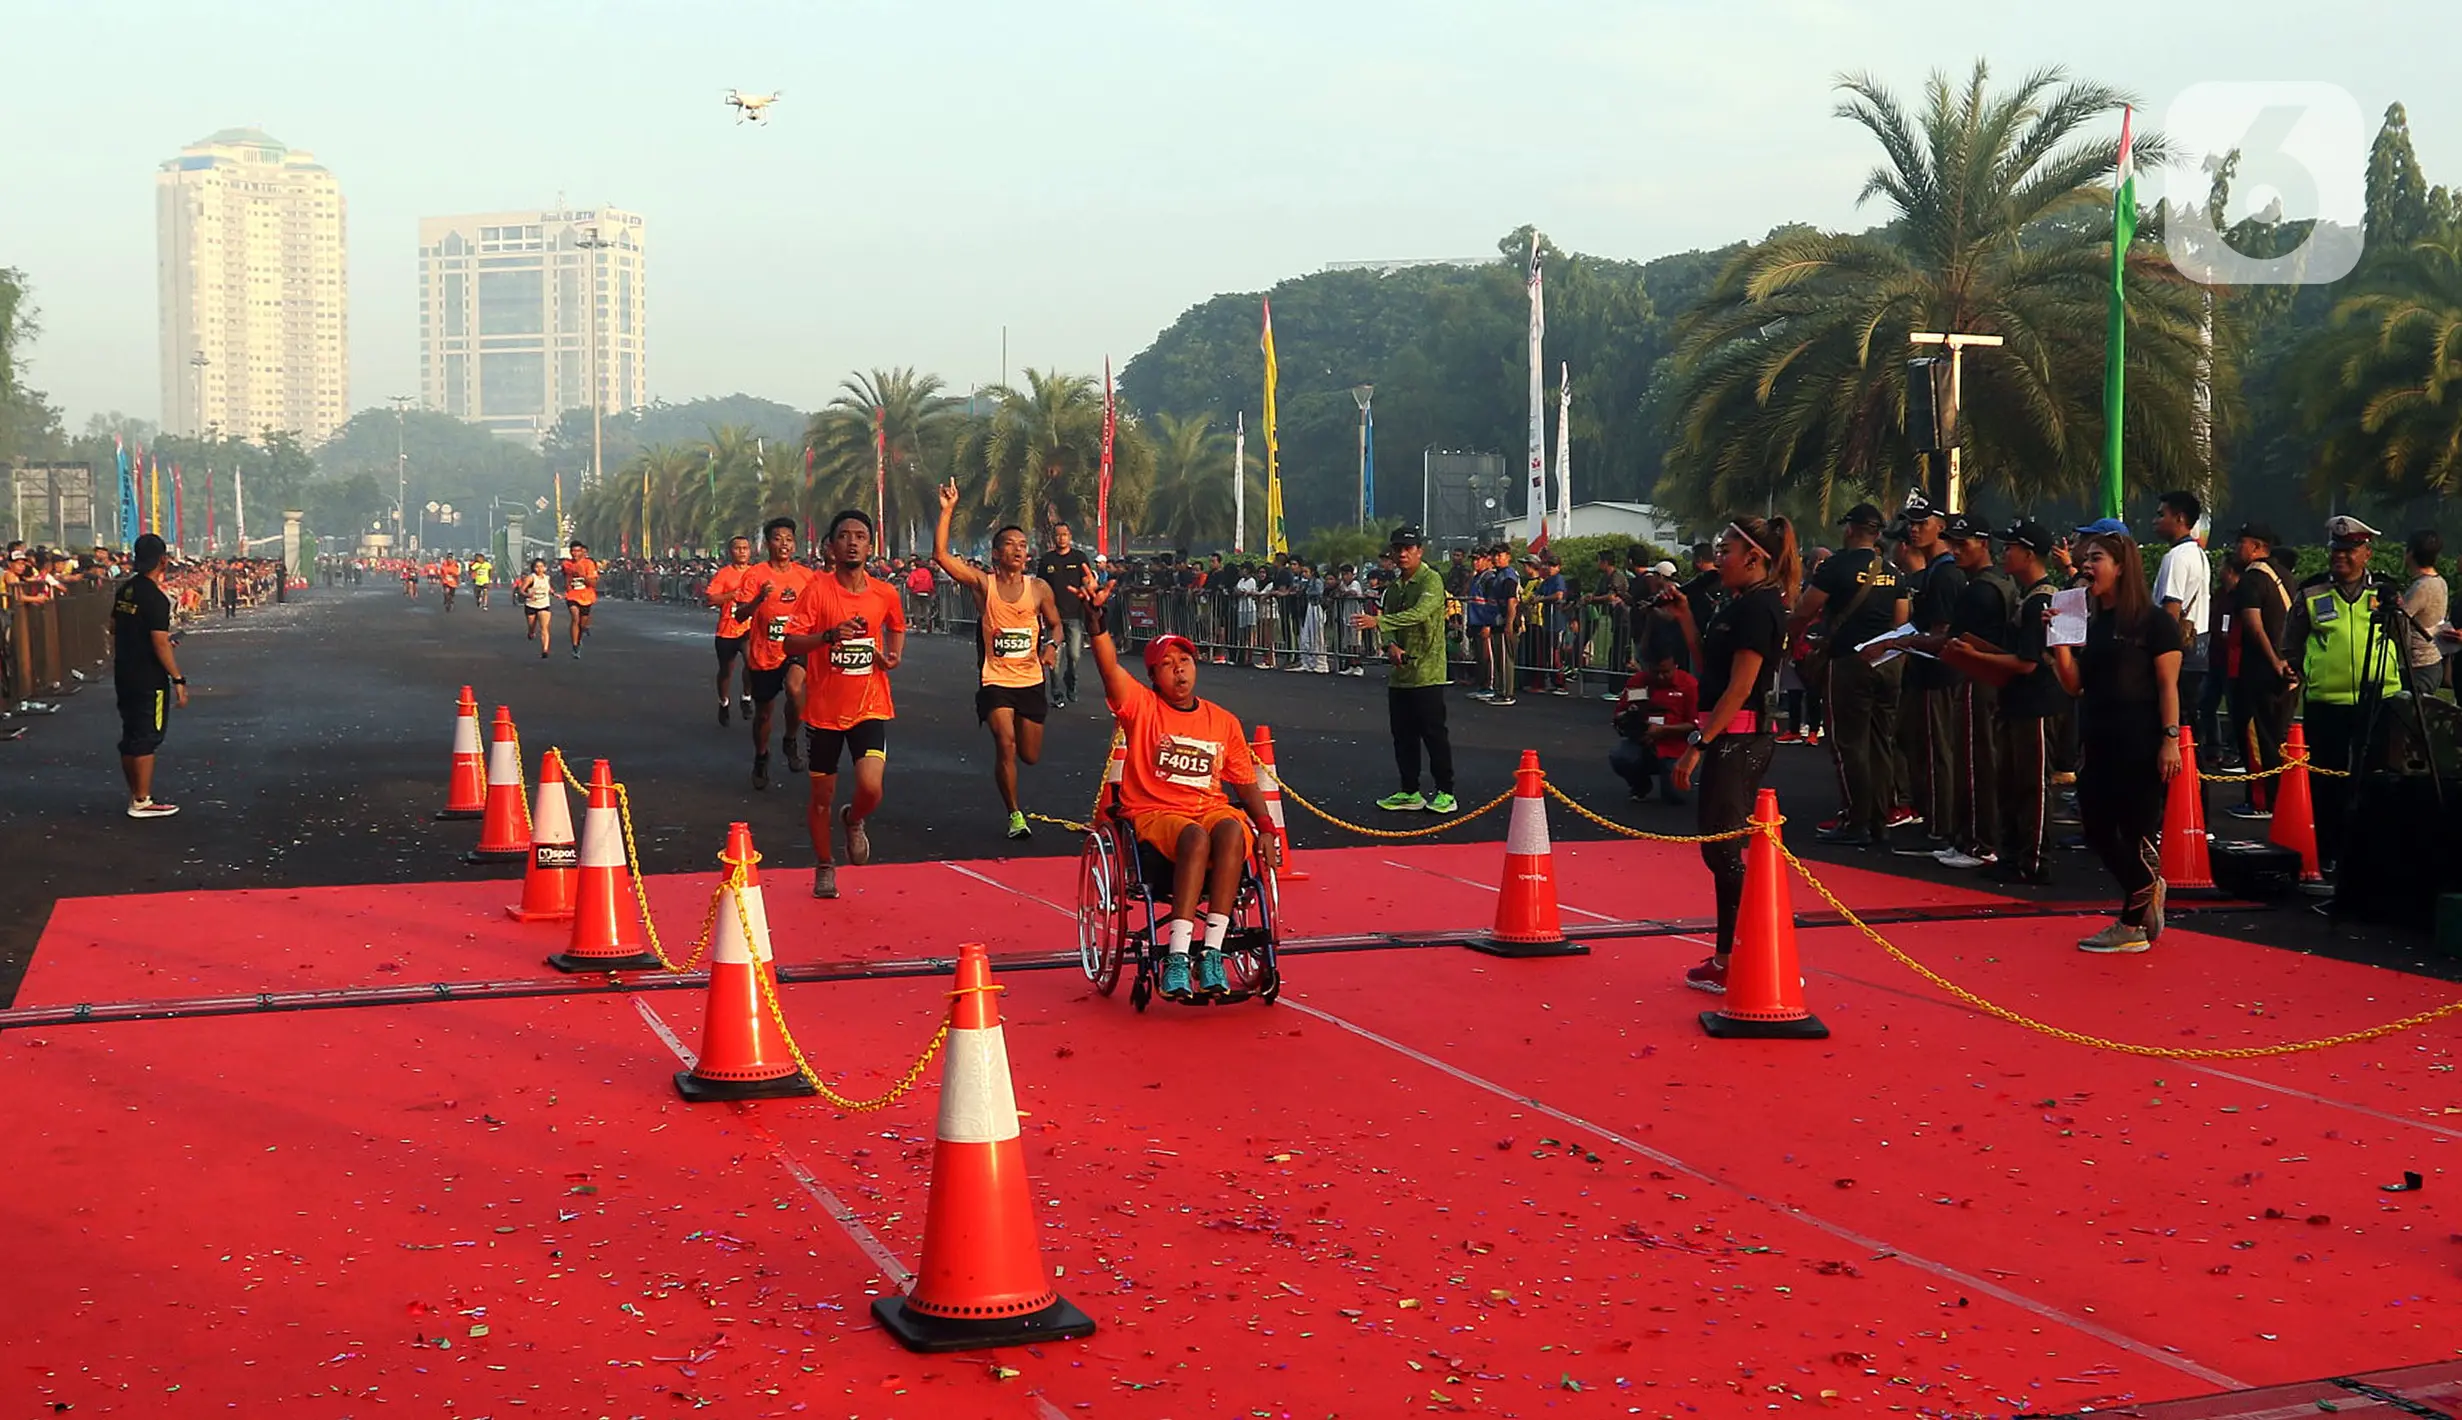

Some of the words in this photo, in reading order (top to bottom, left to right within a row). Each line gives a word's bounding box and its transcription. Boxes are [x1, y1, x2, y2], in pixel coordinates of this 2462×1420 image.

[1857, 572, 1895, 586] CEW
[994, 638, 1031, 649] M5526
[831, 652, 873, 665] M5720
[1159, 752, 1210, 773] F4015
